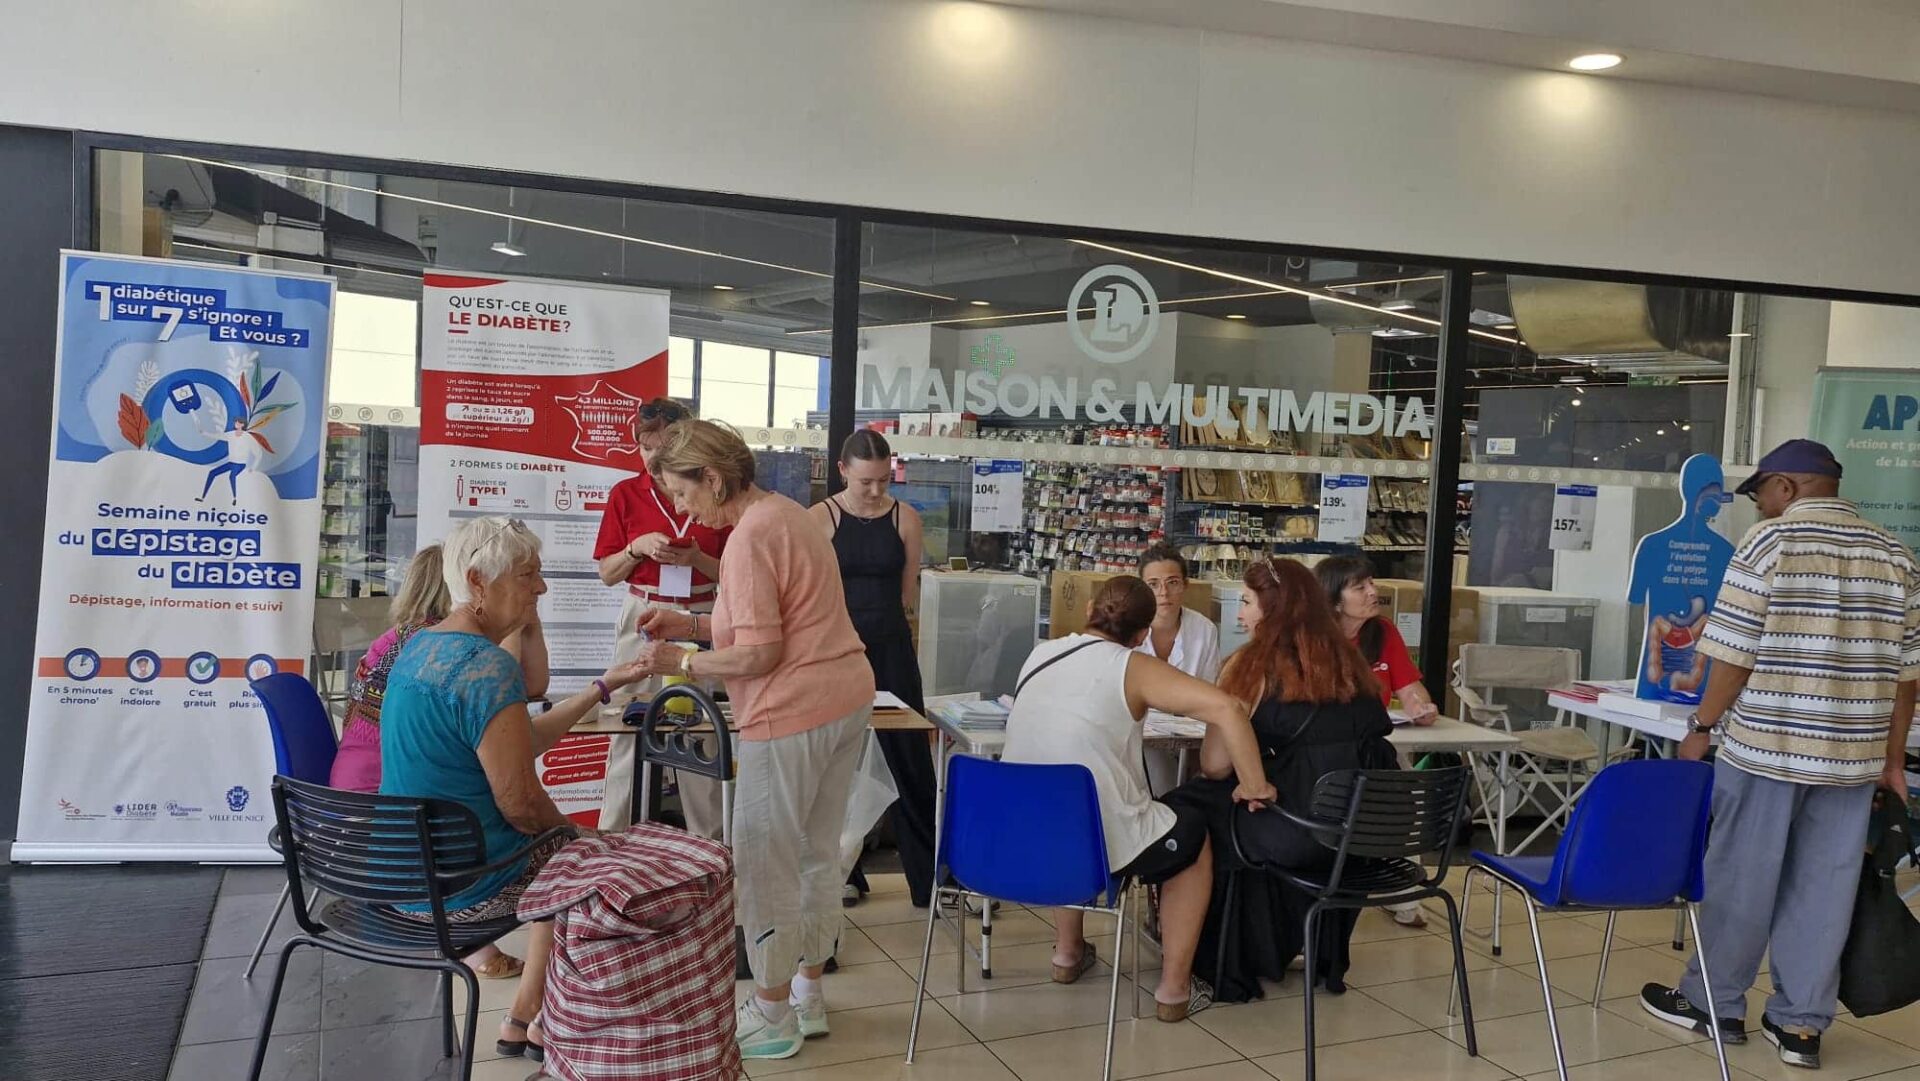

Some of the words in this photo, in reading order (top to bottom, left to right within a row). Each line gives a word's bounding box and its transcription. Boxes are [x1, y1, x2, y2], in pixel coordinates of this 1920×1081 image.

[93, 284, 111, 321] 1
[113, 285, 216, 307] diabétique
[449, 295, 531, 313] QU'EST-CE
[536, 303, 568, 316] QUE
[117, 302, 147, 316] sur
[151, 305, 184, 342] 7
[188, 307, 263, 327] s'ignore
[267, 314, 273, 327] !
[449, 312, 472, 326] LE
[478, 314, 571, 333] DIABÈTE?
[219, 326, 238, 340] Et
[242, 330, 287, 344] vous
[292, 333, 302, 346] ?
[593, 397, 635, 407] MILLIONS
[861, 363, 1079, 421] MAISON
[1084, 378, 1127, 424] &
[1134, 381, 1432, 440] MULTIMEDIA
[1862, 394, 1920, 431] AP
[1846, 437, 1888, 449] Action
[1891, 439, 1905, 449] et
[450, 460, 456, 468] 2
[459, 460, 503, 469] FORMES
[506, 462, 520, 471] DE
[521, 462, 566, 473] DIABÈTE
[1876, 456, 1892, 467] de
[1895, 457, 1908, 467] la
[469, 486, 499, 495] TYPE
[501, 487, 506, 496] 1
[577, 491, 605, 499] TYPE
[97, 502, 190, 521] Semaine
[196, 508, 268, 526] niçoise
[58, 530, 85, 546] du
[95, 529, 258, 560] dépistage
[1668, 540, 1711, 551] Comprendre
[137, 563, 165, 579] du
[175, 561, 297, 588] diabète
[1662, 575, 1679, 584] dans
[69, 594, 146, 610] Dépistage,
[149, 596, 231, 610] information
[235, 600, 249, 611] et
[252, 599, 284, 612] suivi
[47, 685, 61, 694] En
[62, 686, 69, 694] 5
[71, 686, 114, 695] minutes
[129, 687, 154, 697] C'est
[188, 689, 213, 698] C'est
[120, 698, 161, 707] indolore
[183, 698, 217, 710] gratuit
[229, 700, 250, 710] plus
